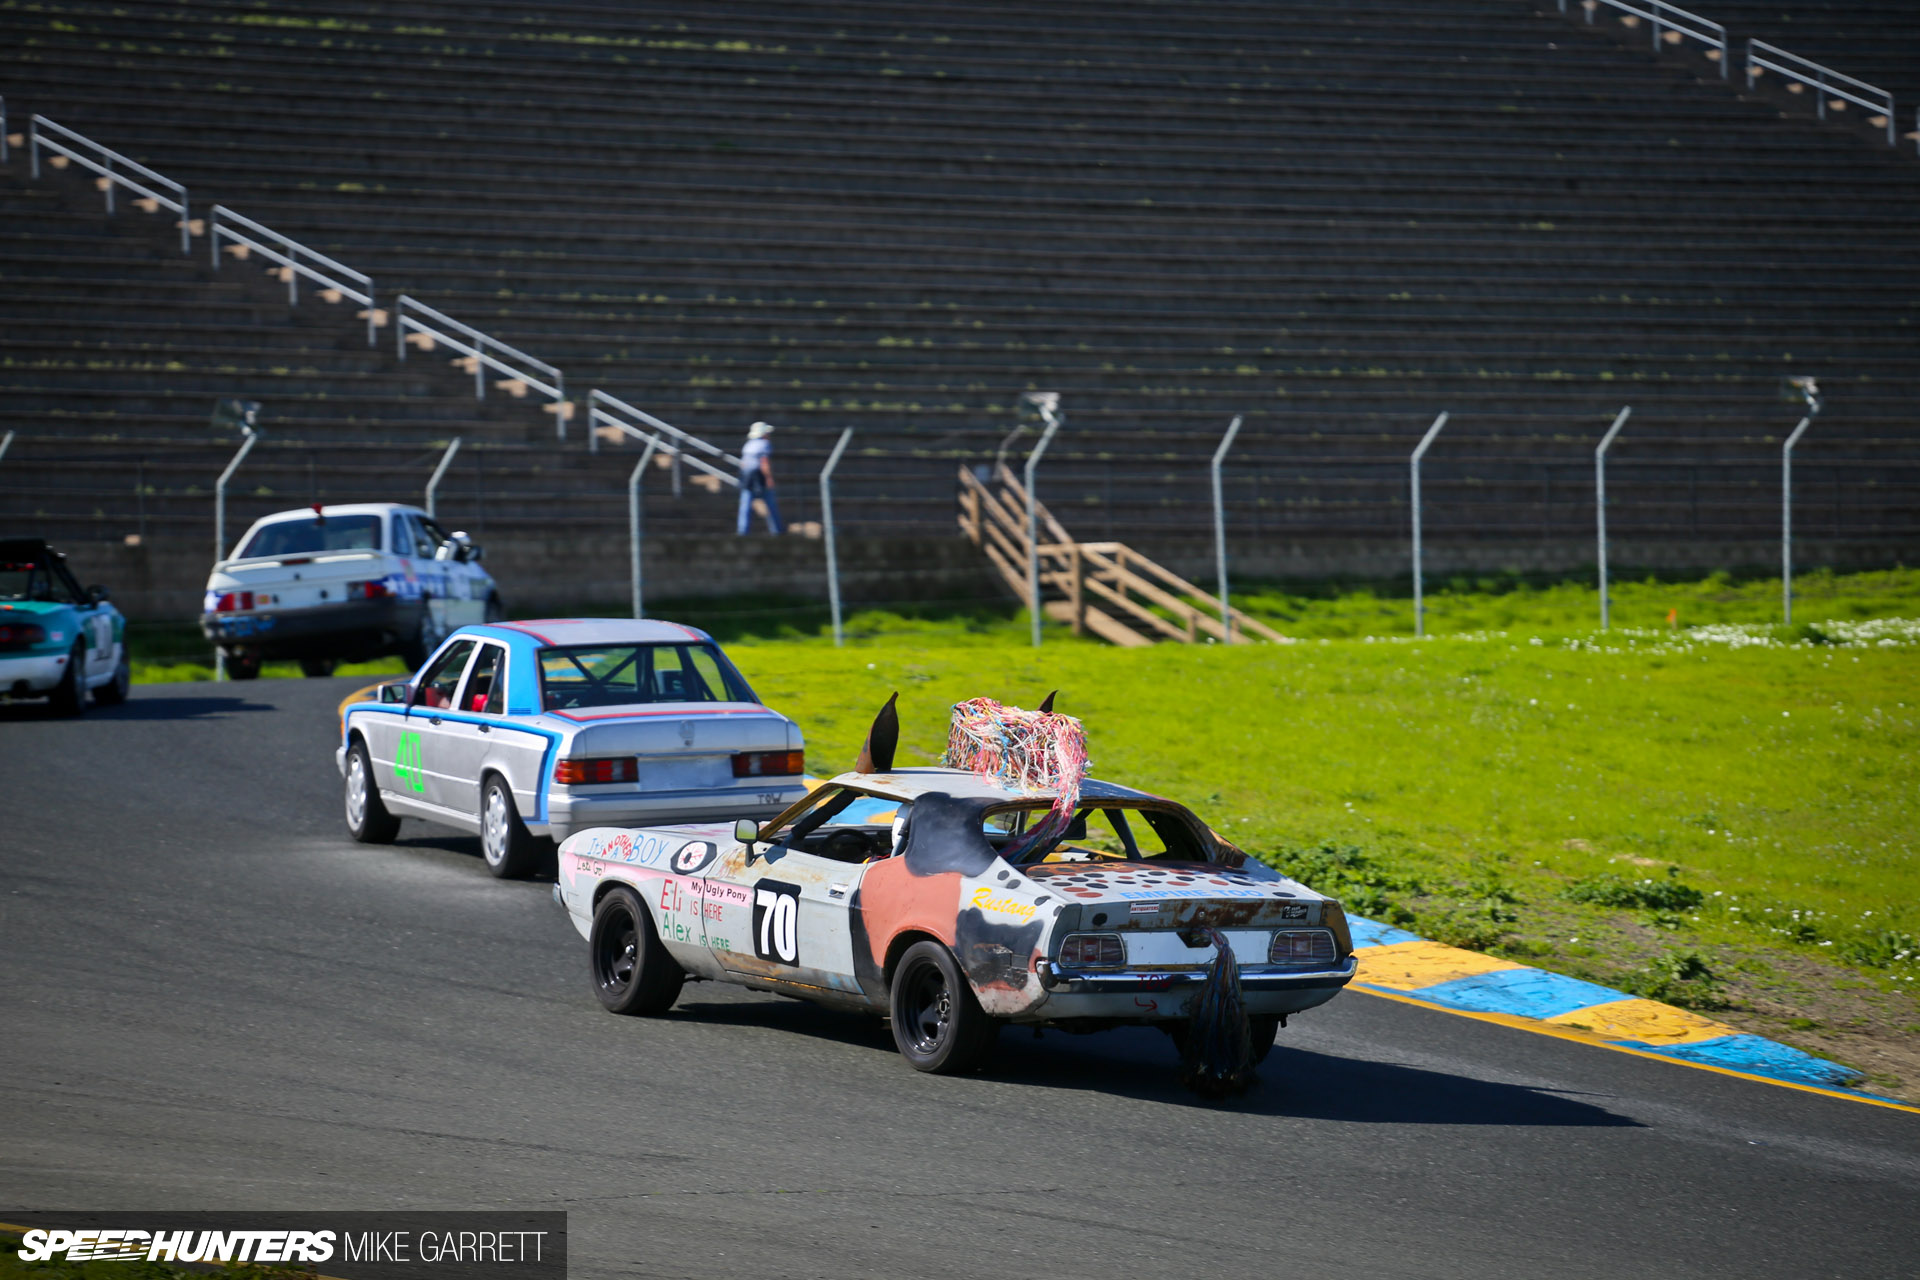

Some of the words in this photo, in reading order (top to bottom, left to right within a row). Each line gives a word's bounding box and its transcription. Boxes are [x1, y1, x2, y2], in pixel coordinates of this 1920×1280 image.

[394, 731, 424, 792] 40
[757, 792, 783, 804] TOW
[601, 834, 632, 859] ANOTHER
[627, 834, 670, 865] BOY
[660, 878, 682, 912] Eli
[690, 899, 699, 916] IS
[704, 903, 723, 922] HERE
[691, 881, 703, 894] My
[705, 884, 724, 898] Ugly
[726, 888, 747, 902] Pony
[968, 887, 1036, 924] Rustang
[1120, 889, 1213, 900] EMPIRE
[662, 912, 691, 943] Alex
[699, 935, 707, 948] IS
[711, 936, 731, 952] HERE
[756, 889, 797, 962] 70
